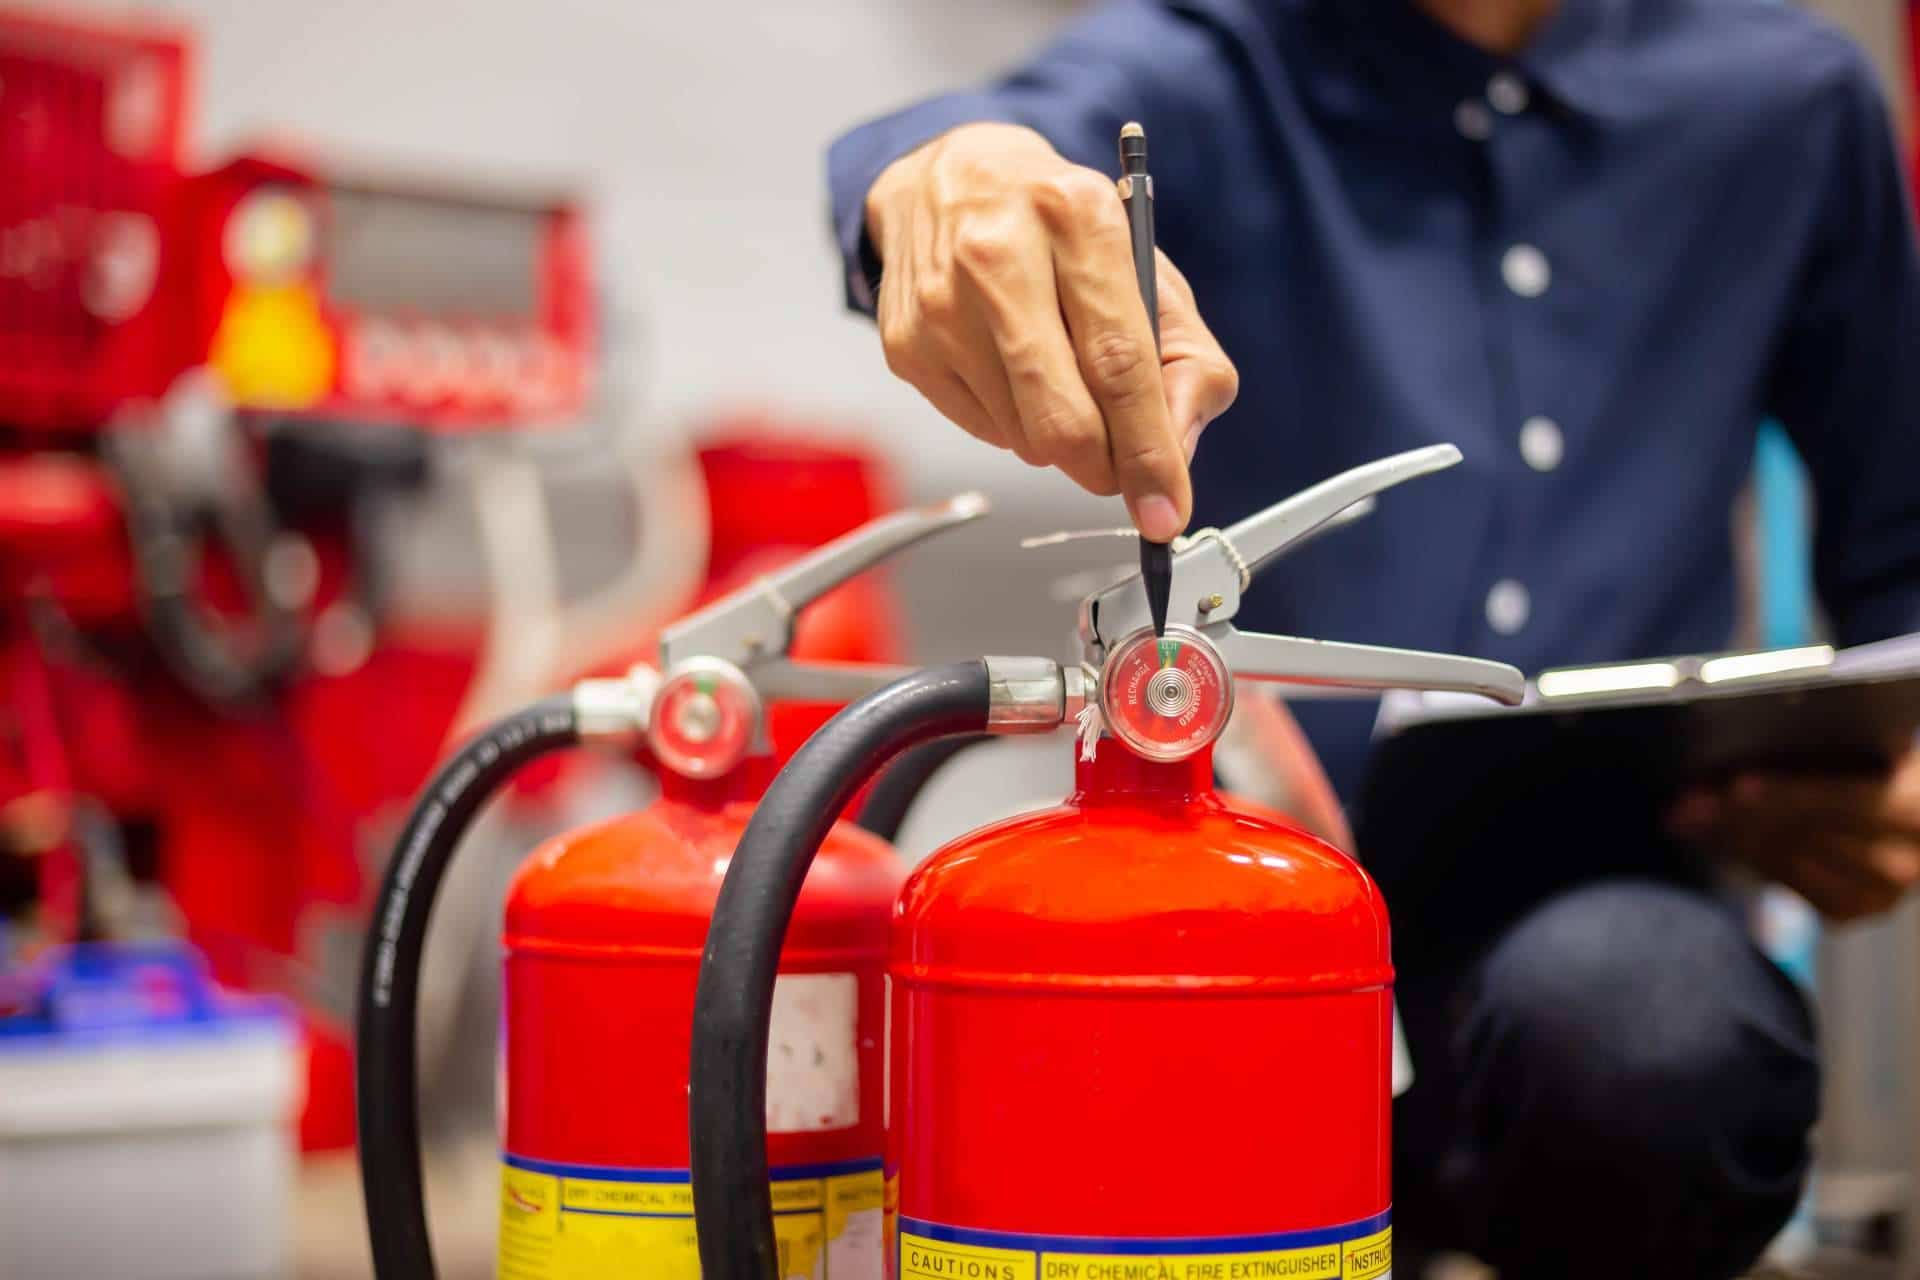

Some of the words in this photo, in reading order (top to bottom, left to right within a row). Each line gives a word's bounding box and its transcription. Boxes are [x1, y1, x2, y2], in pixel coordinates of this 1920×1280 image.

[911, 1251, 1015, 1280] CAUTIONS
[1046, 1262, 1080, 1279] DRY
[1087, 1262, 1181, 1280] CHEMICAL
[1186, 1263, 1223, 1280] FIRE
[1231, 1253, 1336, 1279] EXTINGUISHER
[1351, 1244, 1390, 1273] INSTRUC
